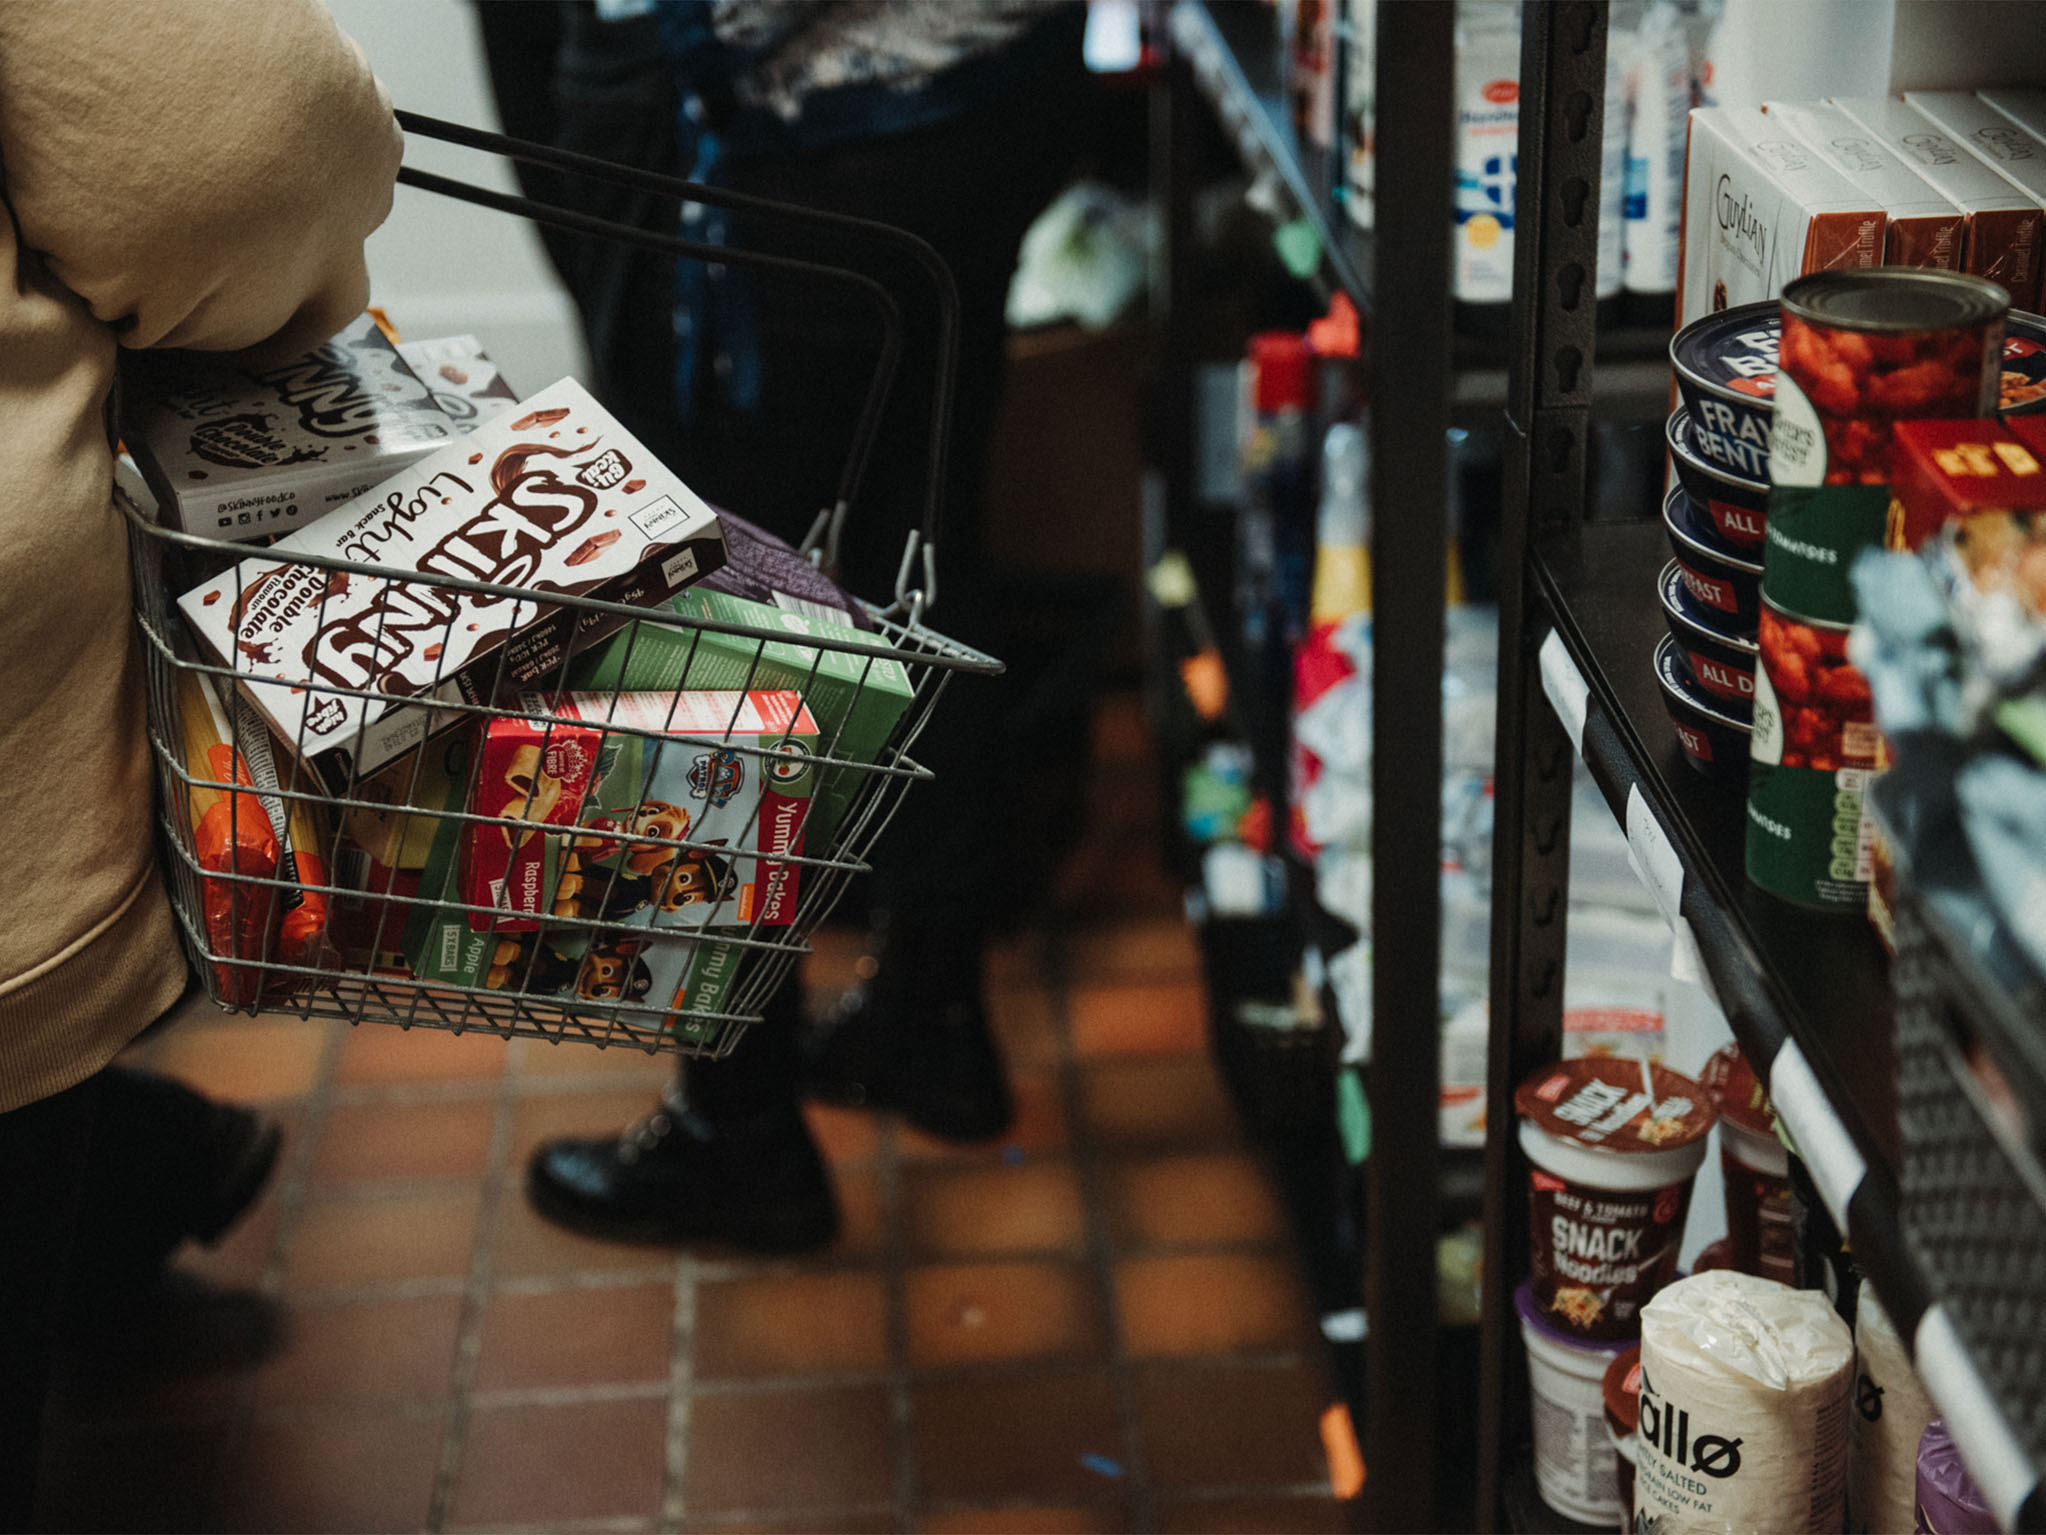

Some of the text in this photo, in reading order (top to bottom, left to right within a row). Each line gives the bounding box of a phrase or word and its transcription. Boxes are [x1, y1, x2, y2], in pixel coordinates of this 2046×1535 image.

[1695, 424, 1771, 476] BENT
[335, 503, 385, 548] Snack Bar
[345, 472, 474, 563] Light
[1724, 511, 1760, 534] ALL
[251, 577, 281, 611] Flavour
[303, 470, 598, 690] SKINNY
[269, 576, 324, 633] Double
[1703, 663, 1734, 687] ALL
[305, 700, 340, 727] fibre
[315, 711, 345, 733] high
[547, 750, 558, 774] FIBRE
[698, 760, 709, 793] PATROL
[520, 861, 540, 917] Raspberr
[764, 871, 789, 920] Bakes
[464, 937, 485, 973] Apple
[1552, 1214, 1643, 1261] SNACK
[1553, 1250, 1638, 1285] Noodles
[1641, 1393, 1743, 1478] allø
[1659, 1463, 1707, 1496] SALTED
[1652, 1490, 1680, 1514] CAKES
[1667, 1486, 1690, 1505] LOW
[1693, 1500, 1713, 1513] FAT
